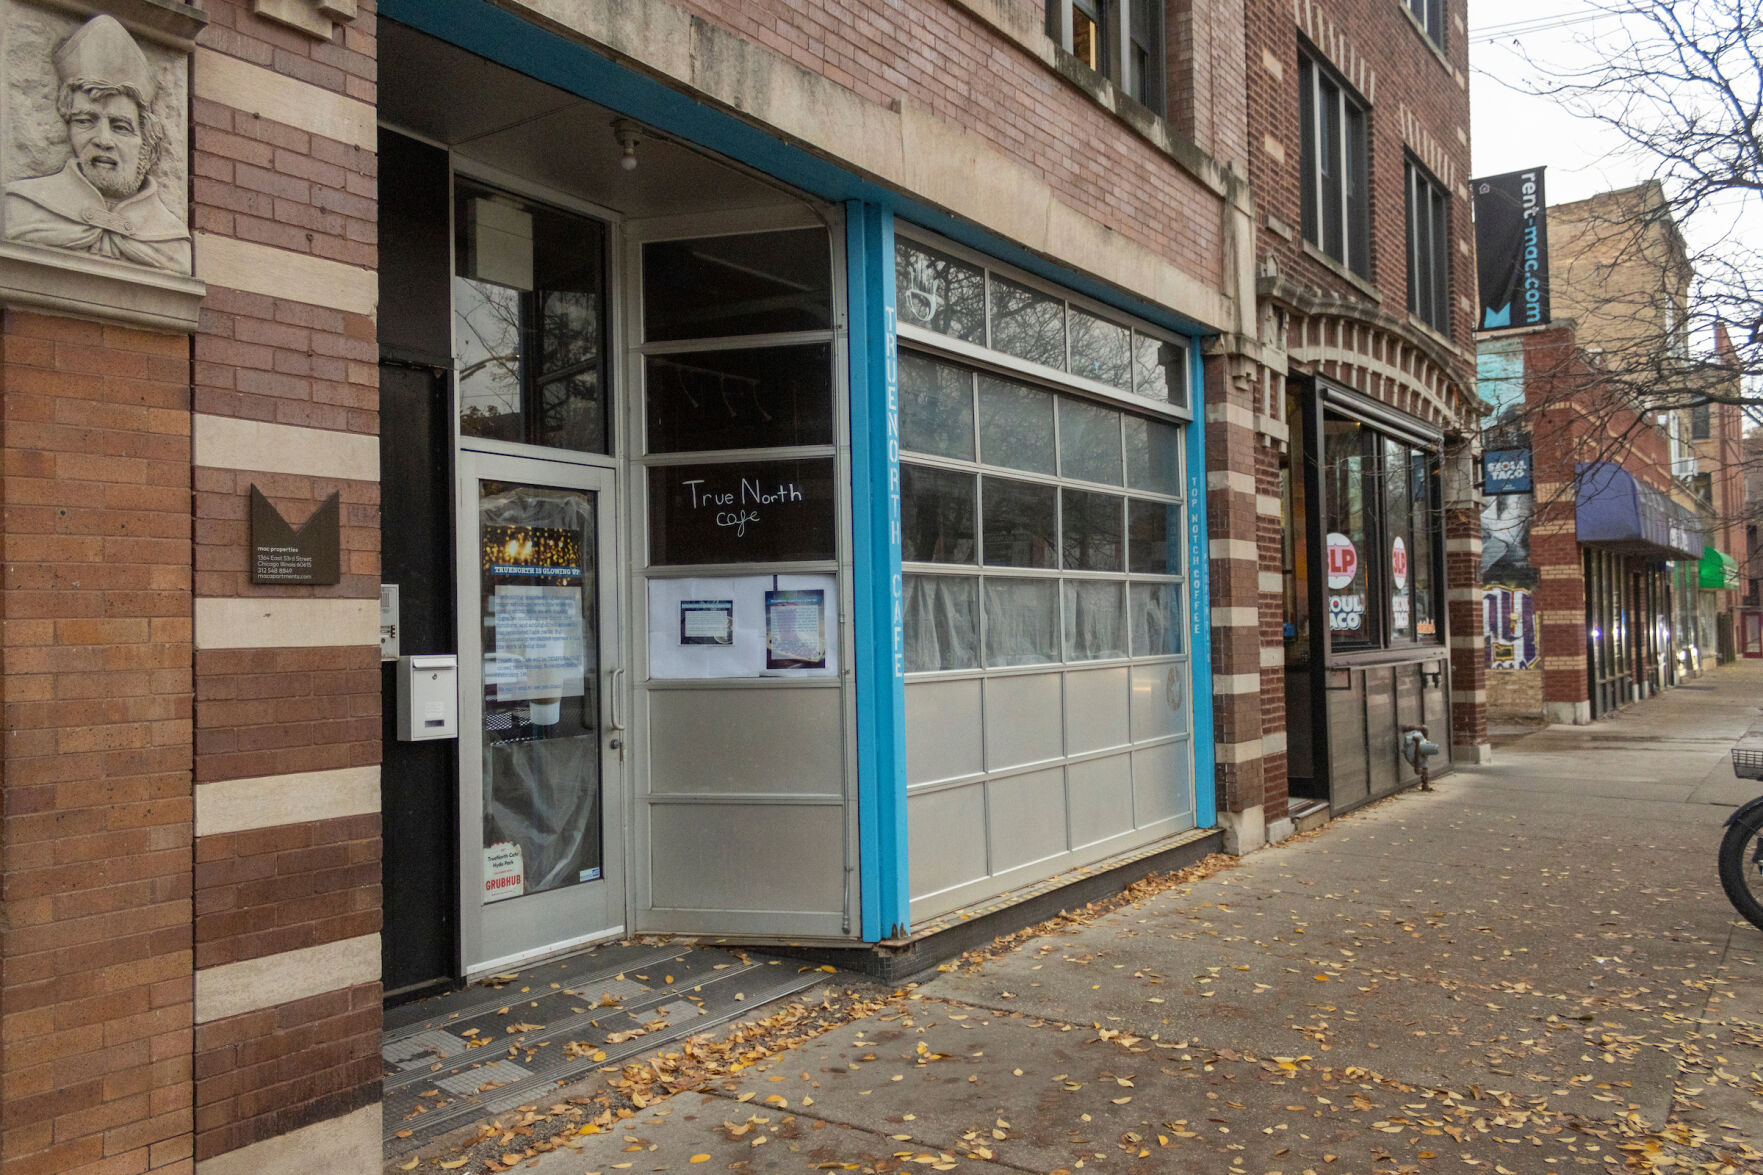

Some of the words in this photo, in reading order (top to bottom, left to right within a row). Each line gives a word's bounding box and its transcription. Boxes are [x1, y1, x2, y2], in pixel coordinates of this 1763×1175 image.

[1521, 172, 1541, 323] rent-mac.com
[885, 305, 900, 545] TRUENORTH
[682, 479, 734, 509] True
[741, 477, 803, 504] North
[1191, 514, 1199, 565] NOTCH
[1328, 549, 1355, 573] LP
[892, 573, 903, 678] CAFE
[1193, 569, 1201, 634] COFFEE
[1328, 612, 1361, 630] ACO
[485, 874, 521, 891] GRUBHUB
